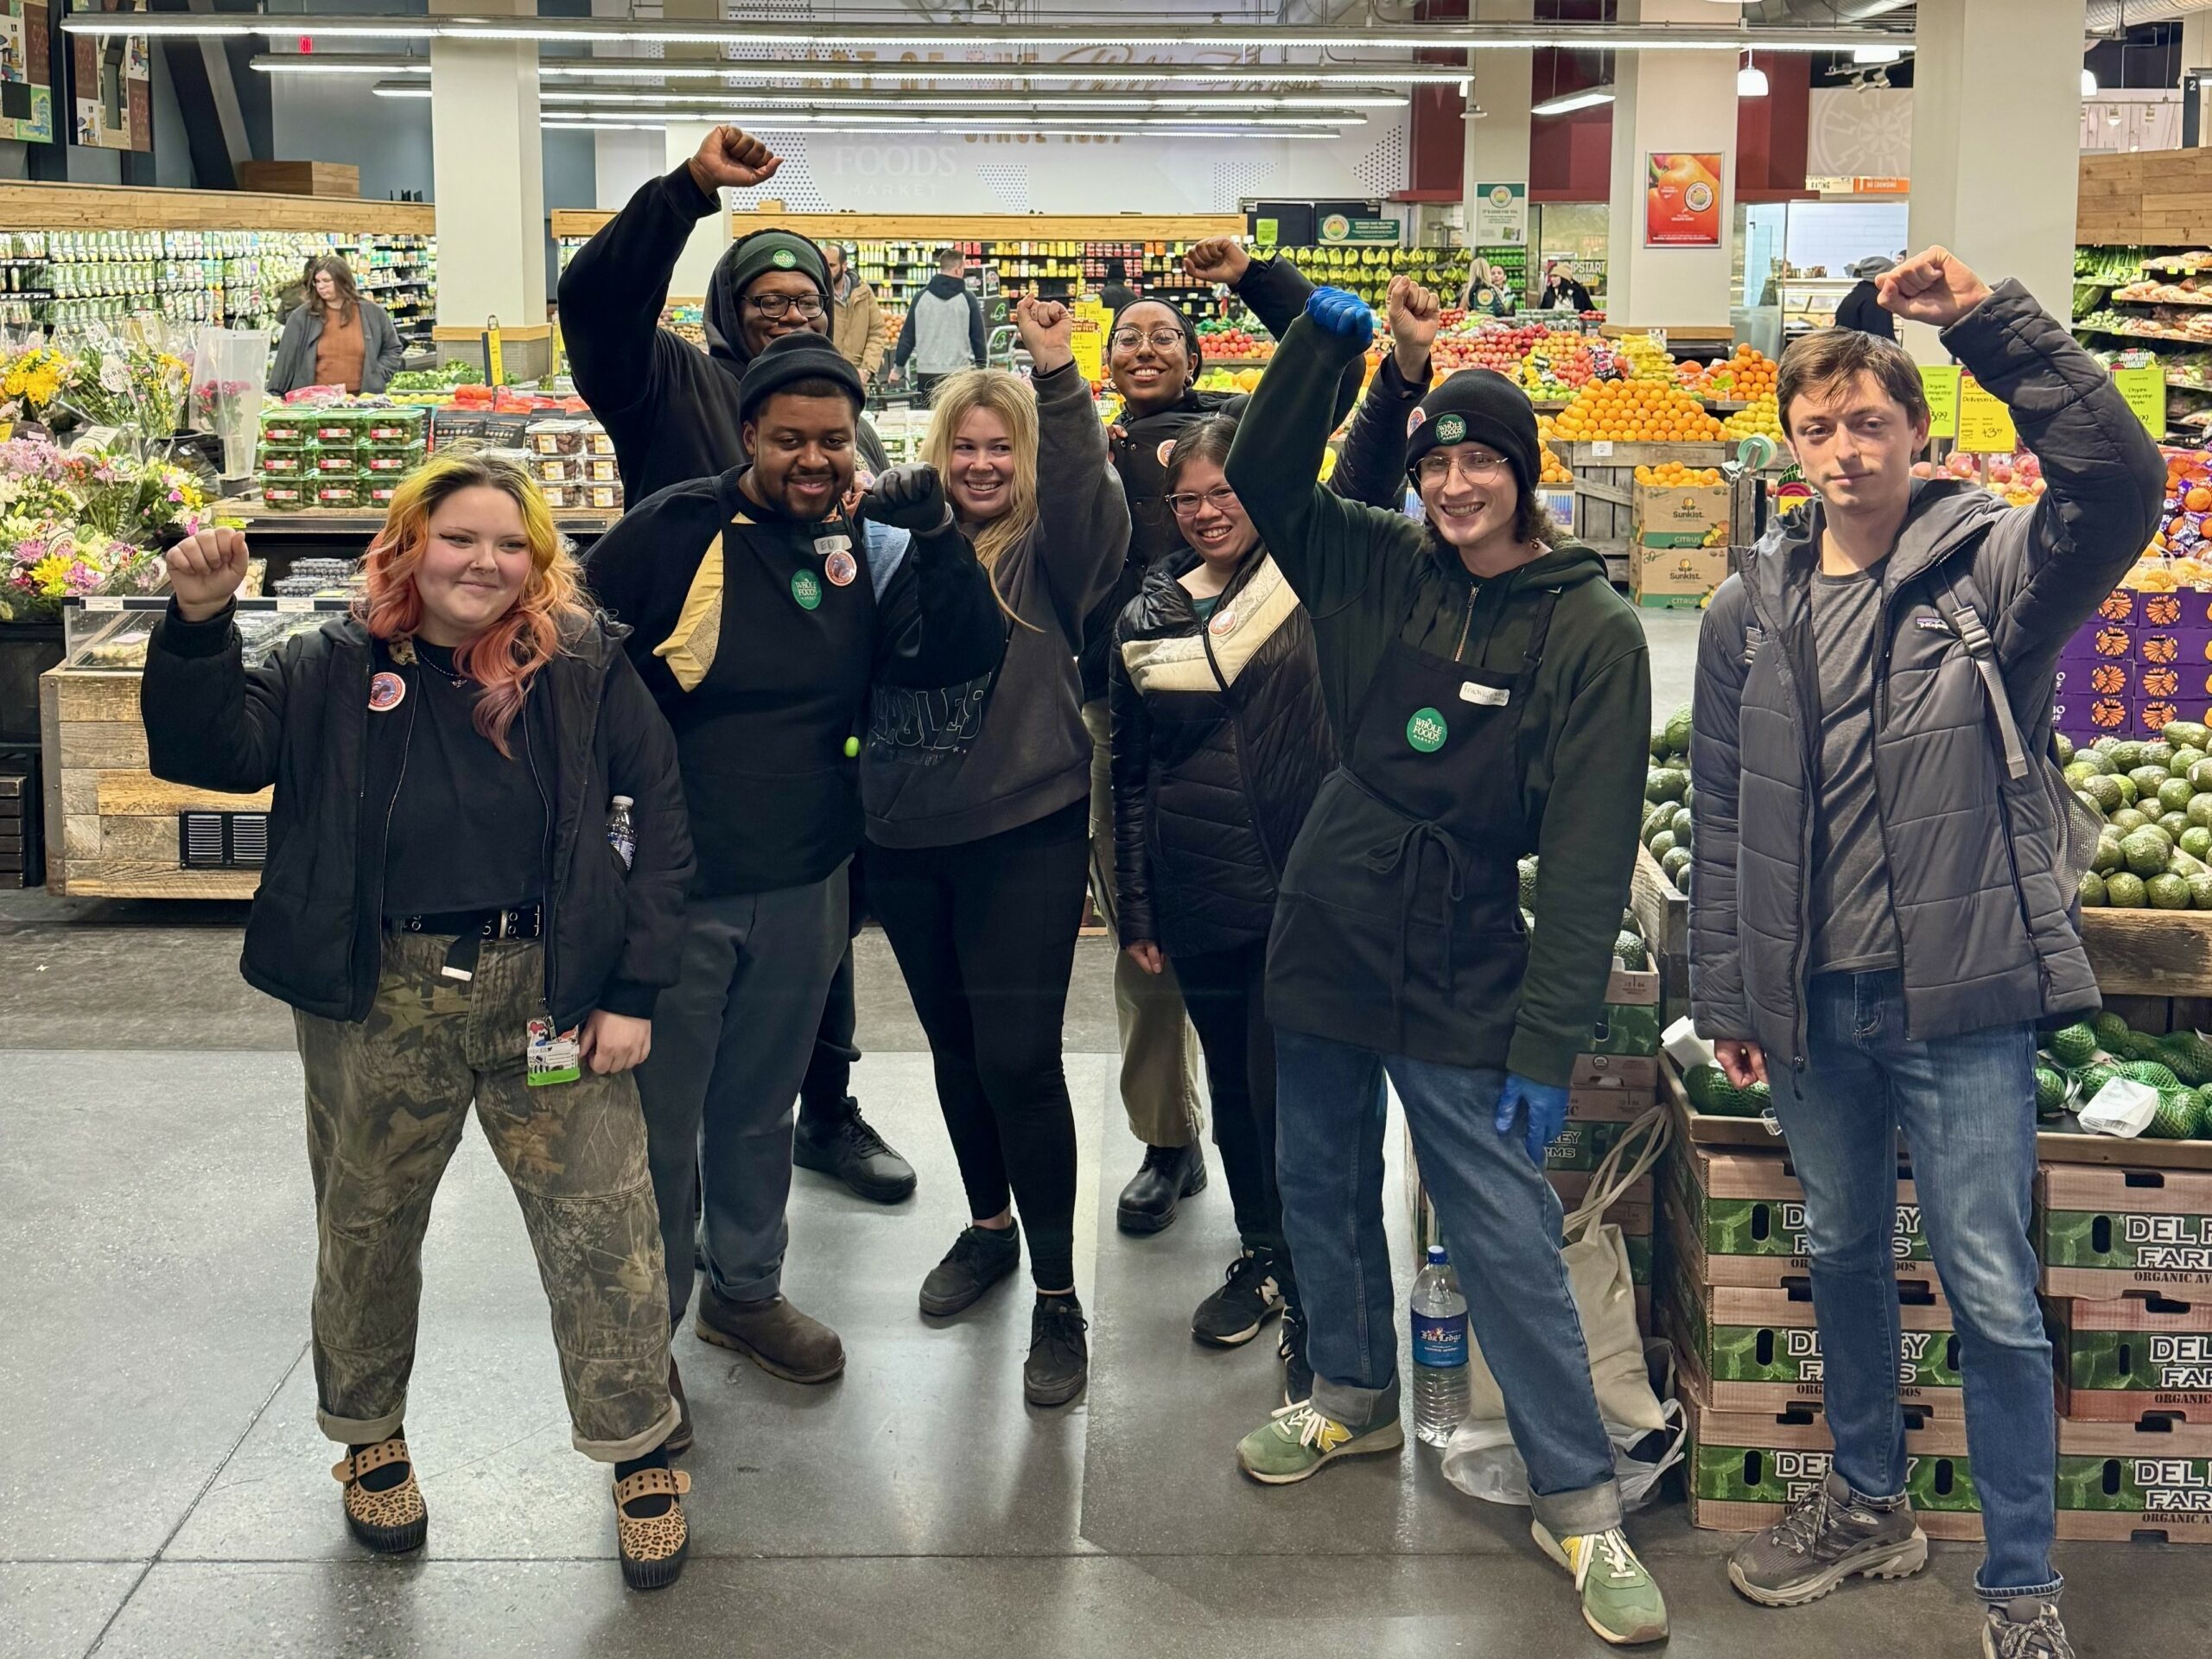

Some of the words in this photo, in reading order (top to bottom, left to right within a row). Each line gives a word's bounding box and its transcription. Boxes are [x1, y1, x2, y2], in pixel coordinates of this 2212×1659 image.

[2189, 79, 2196, 91] 2
[831, 144, 957, 177] FOODS
[849, 183, 939, 196] MARKET
[1573, 261, 1605, 274] PSTART
[819, 538, 834, 550] ED
[795, 578, 817, 589] WHOLE
[1415, 717, 1443, 734] WHOLE
[1413, 726, 1440, 741] FOODS
[2126, 1215, 2197, 1244] DEL
[2137, 1247, 2212, 1269] FAR
[2133, 1271, 2192, 1283] ORGANIC
[2149, 1335, 2212, 1363] DEL
[2154, 1394, 2212, 1404] ORGANIC
[2134, 1459, 2204, 1487] DEL
[2145, 1490, 2212, 1511] FAR
[2143, 1513, 2198, 1524] ORGANIC
